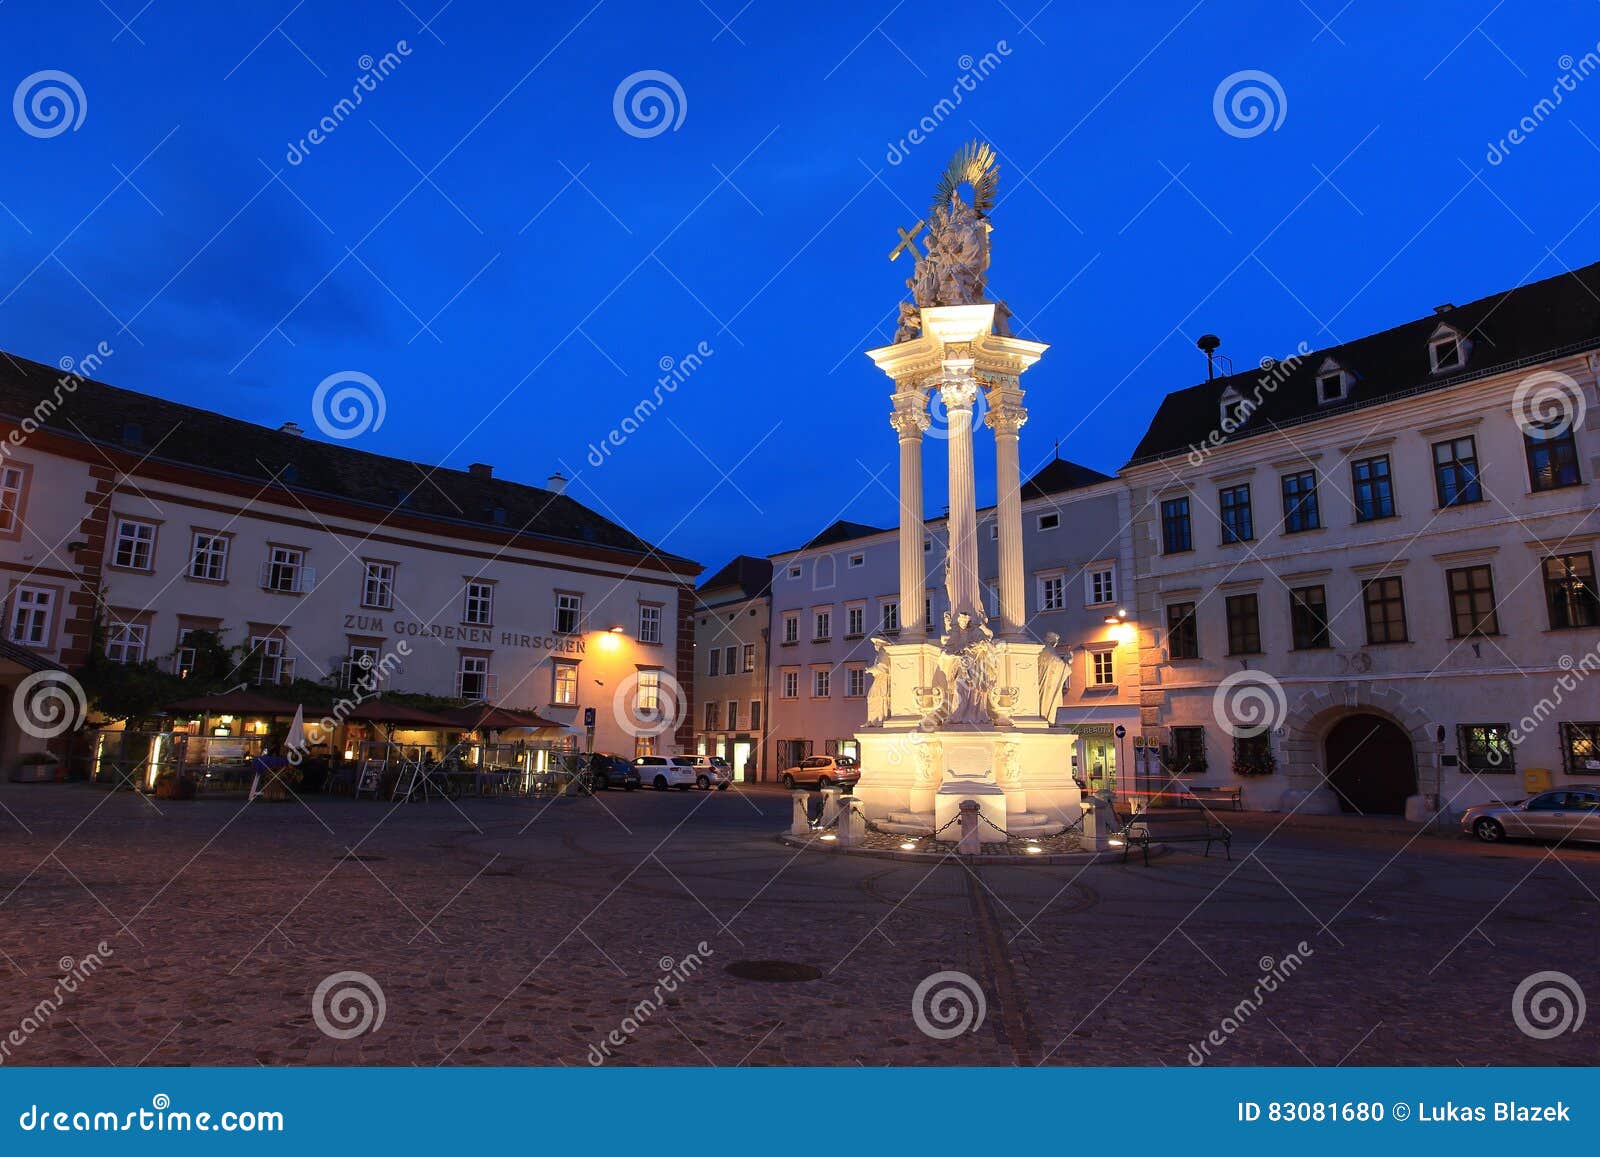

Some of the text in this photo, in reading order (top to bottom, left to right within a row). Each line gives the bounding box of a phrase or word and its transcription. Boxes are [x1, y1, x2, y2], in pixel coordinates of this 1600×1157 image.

[344, 614, 586, 653] ZUM GOLDENEN HIRSCHEN
